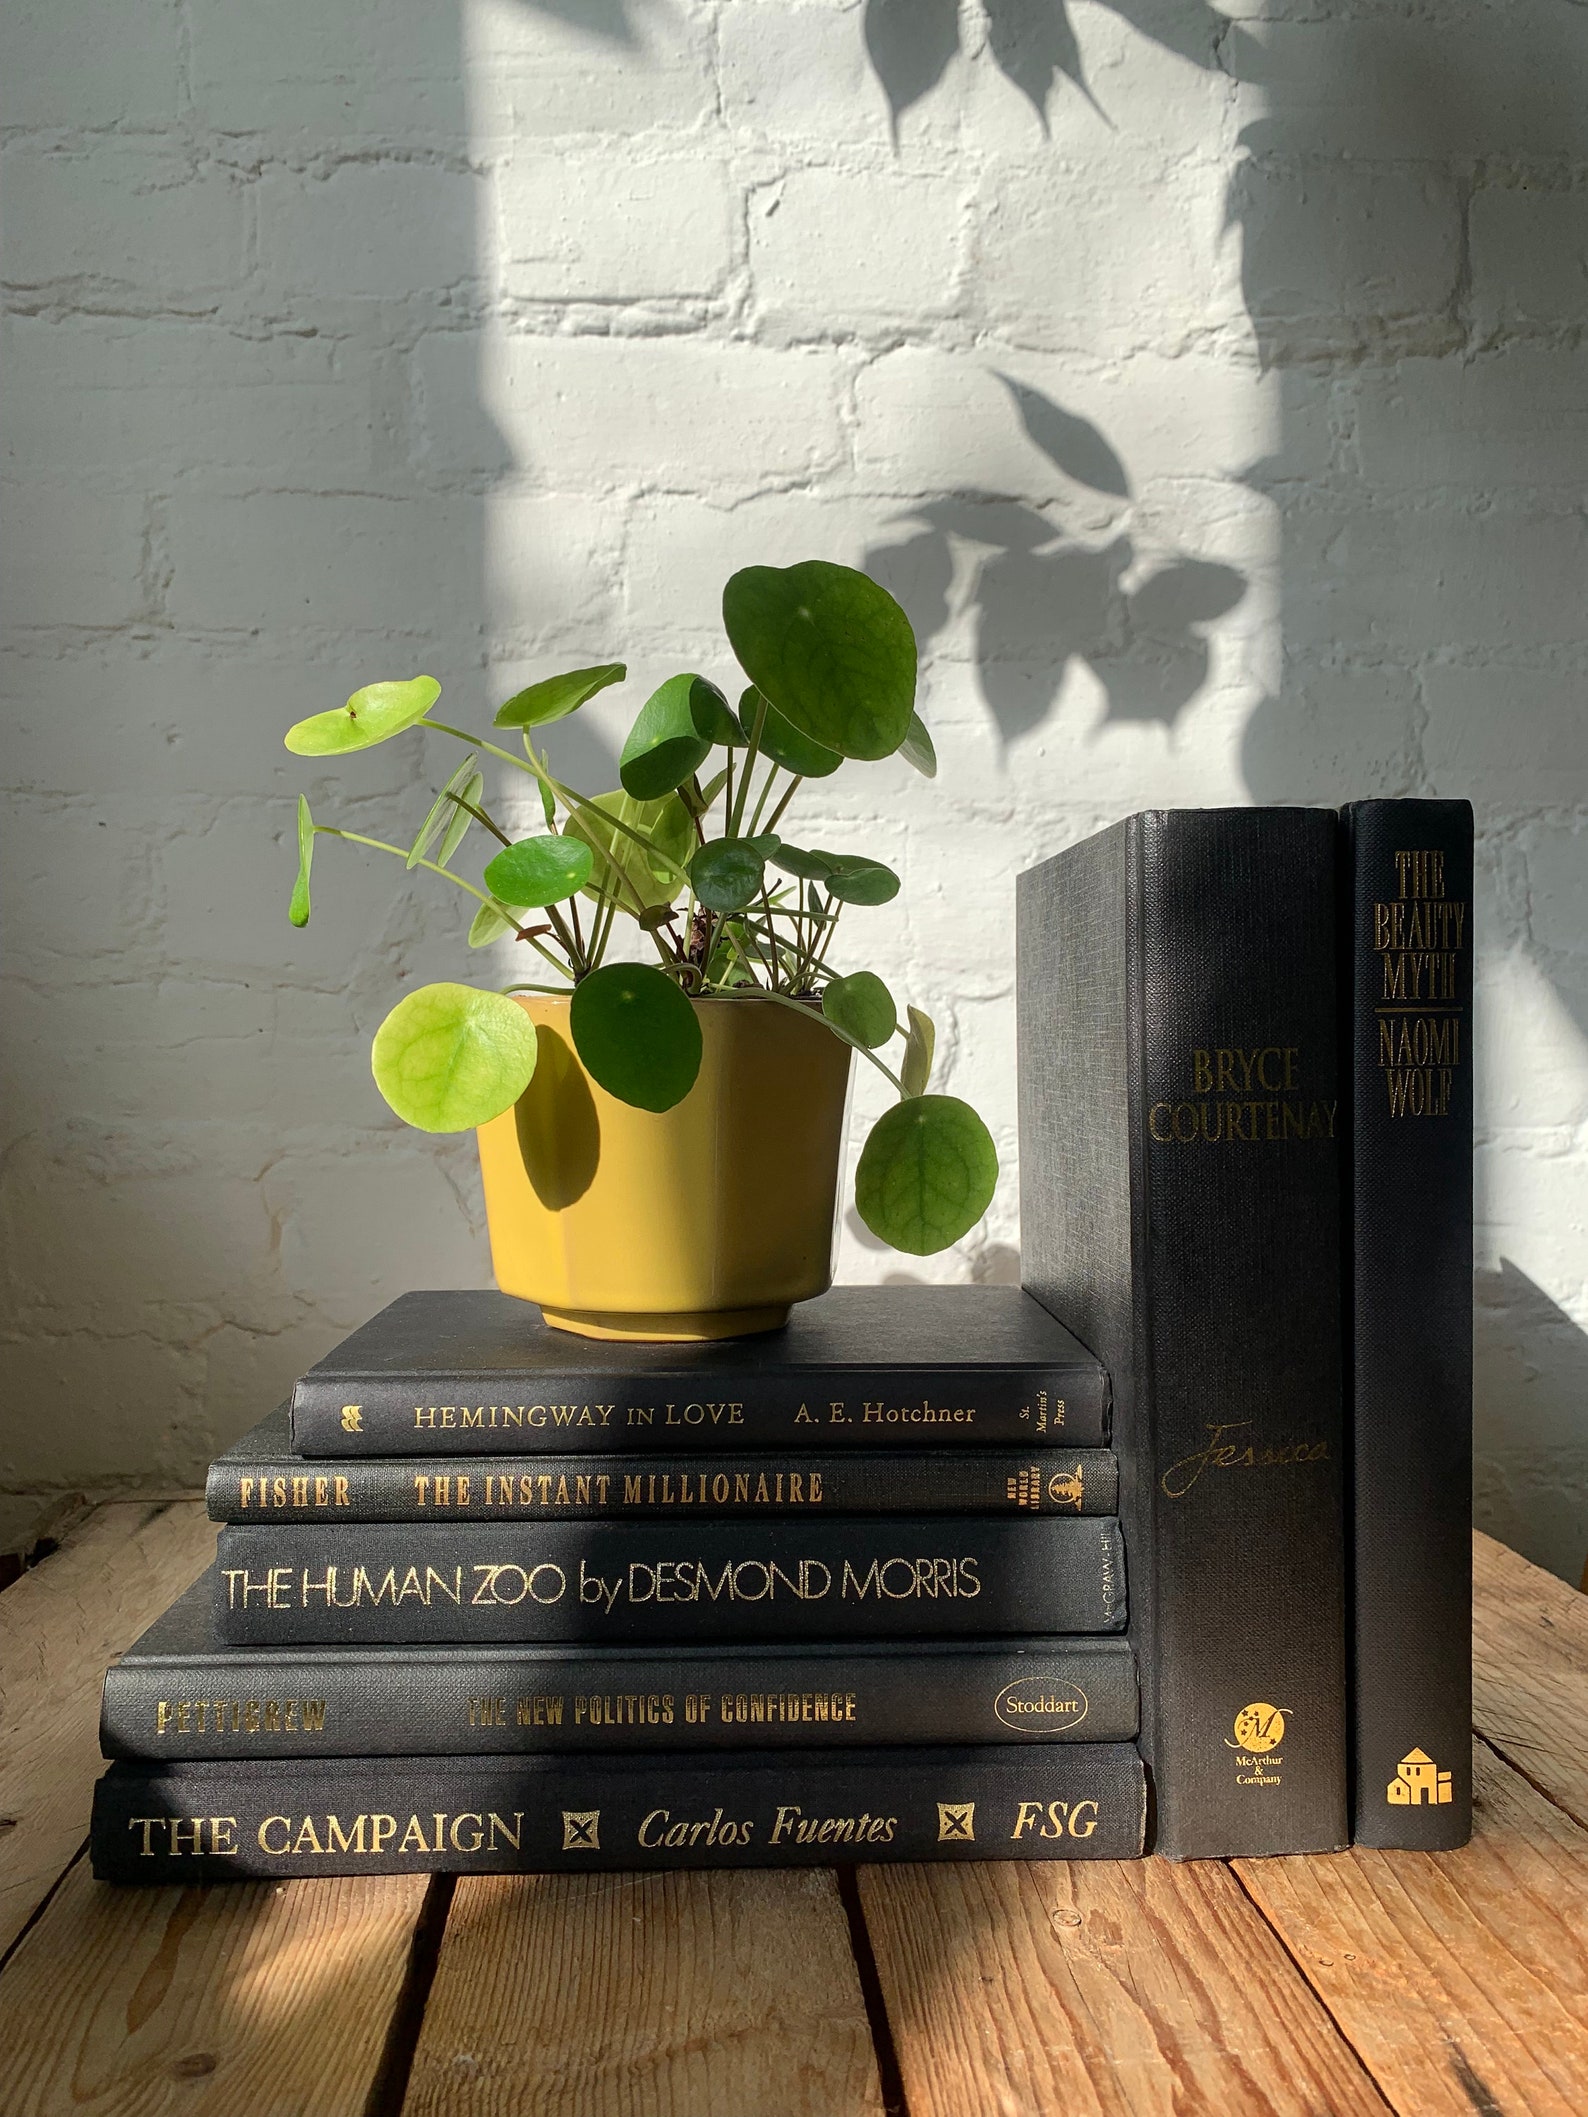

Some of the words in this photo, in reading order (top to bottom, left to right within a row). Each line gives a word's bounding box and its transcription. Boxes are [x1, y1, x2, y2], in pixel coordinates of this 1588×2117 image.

[1395, 851, 1445, 899] THE
[1373, 902, 1465, 950] BEAUTY
[1382, 952, 1457, 1000] MYTH
[1377, 1018, 1461, 1066] NAOMI
[1192, 1047, 1299, 1093] BRYCE
[1386, 1069, 1453, 1118] WOLF
[1148, 1100, 1338, 1142] COURTENAY
[413, 1404, 616, 1429] HEMINGWAY
[627, 1408, 655, 1425] IN
[665, 1403, 745, 1425] LOVE
[794, 1403, 820, 1423] A.
[829, 1402, 853, 1423] E.
[862, 1400, 976, 1423] Hotchner
[1019, 1406, 1030, 1420] St.
[1036, 1390, 1048, 1434] Martin's
[1054, 1399, 1066, 1426] Press
[239, 1475, 351, 1508] FISHER
[414, 1475, 470, 1506] THE
[485, 1474, 611, 1505] INSTANT
[623, 1471, 824, 1504] MILLIONAIRE
[1007, 1477, 1017, 1499] NEW
[1018, 1471, 1029, 1506] WORLD
[1030, 1465, 1041, 1510] LIBRARY
[221, 1567, 293, 1610] THE
[302, 1565, 463, 1608] HUMAN
[472, 1563, 567, 1605] ZOO
[579, 1558, 622, 1615] by
[629, 1559, 832, 1603] DESMOND
[841, 1557, 982, 1600] MORRIS
[157, 1700, 326, 1735] PETTIGREW
[467, 1699, 506, 1727] THE
[516, 1697, 564, 1725] NEW
[575, 1695, 675, 1725] POLITICS
[685, 1694, 712, 1724] OF
[721, 1693, 857, 1723] CONFIDENCE
[1005, 1695, 1079, 1715] Stoddart
[1235, 1755, 1284, 1767] McArthur
[1254, 1766, 1264, 1776] &
[1236, 1774, 1283, 1787] Company
[128, 1817, 239, 1857] THE
[257, 1812, 524, 1855] CAMPAIGN
[637, 1809, 754, 1848] Carlos
[768, 1806, 898, 1845] Fuentes
[1010, 1800, 1100, 1840] FSG
